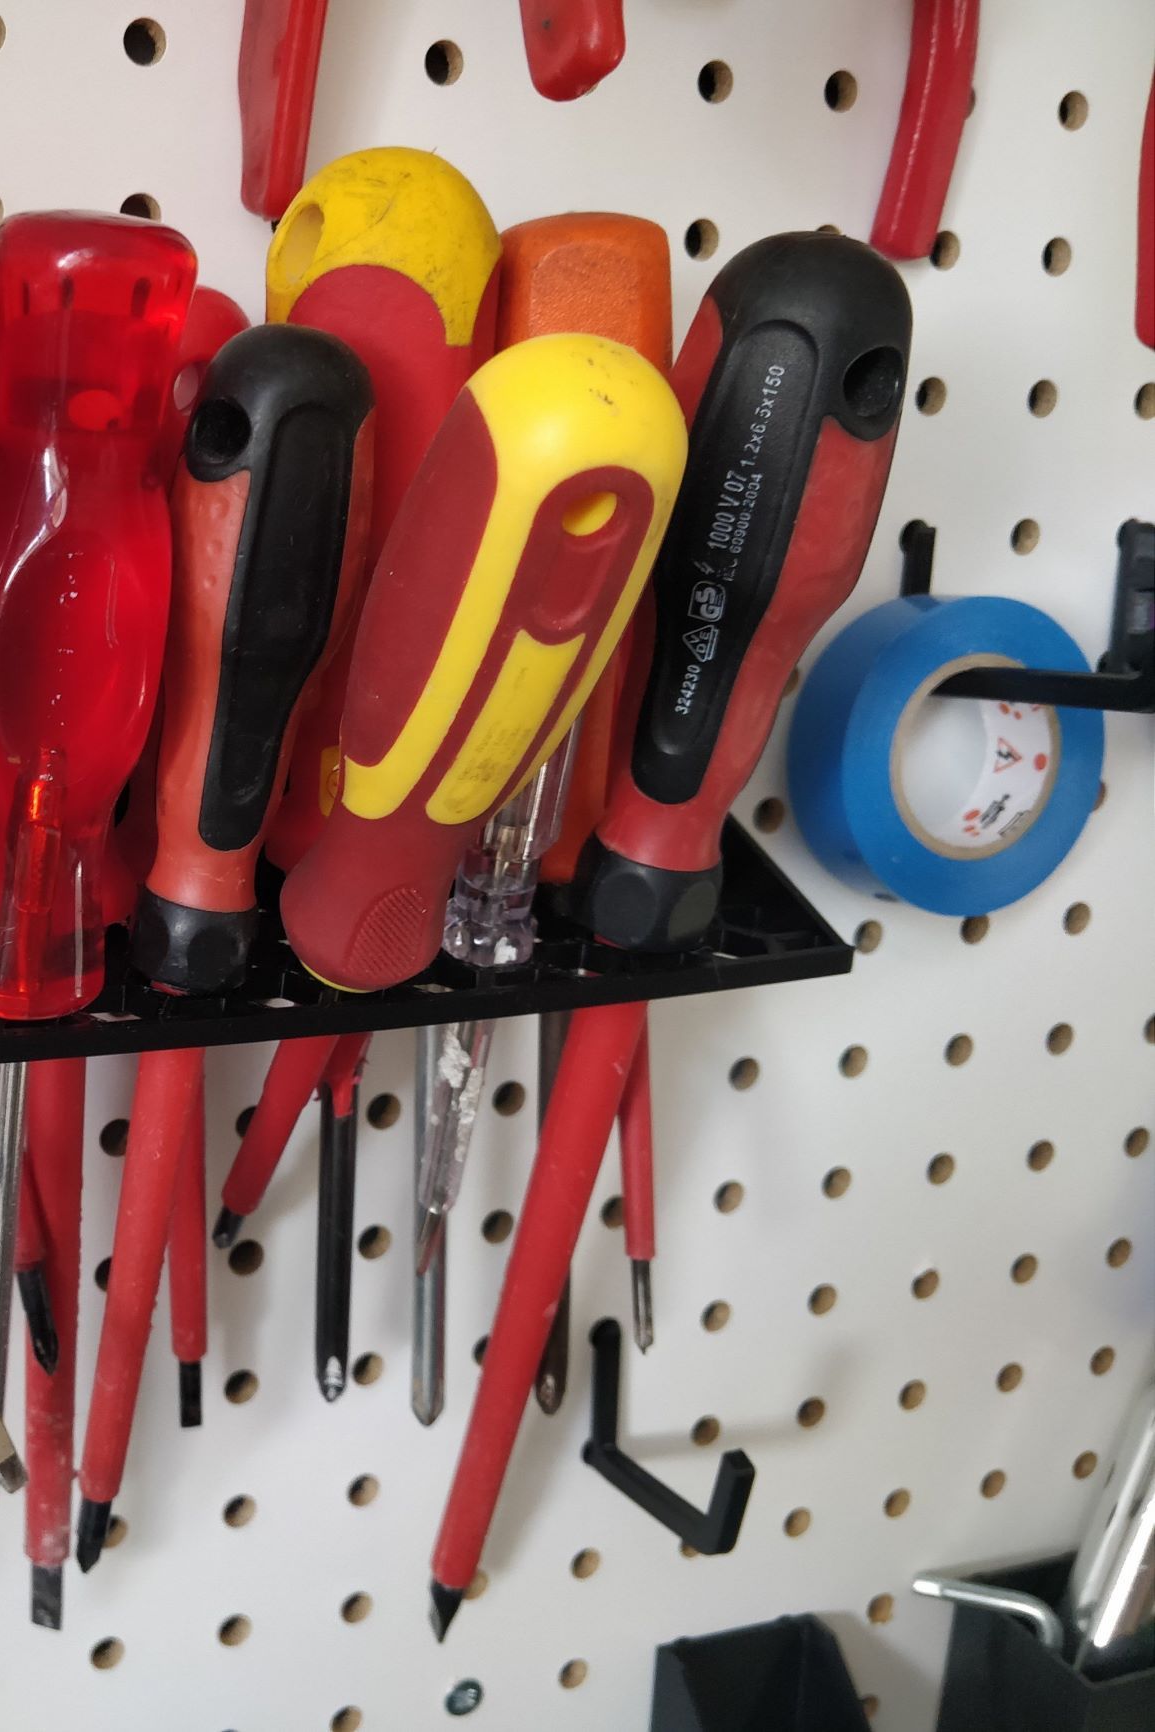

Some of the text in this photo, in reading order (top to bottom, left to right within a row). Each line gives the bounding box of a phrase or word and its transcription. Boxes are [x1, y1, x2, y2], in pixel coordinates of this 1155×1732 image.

[707, 470, 747, 549] 1000 V 07
[696, 586, 721, 619] GS
[674, 664, 702, 715] 324230
